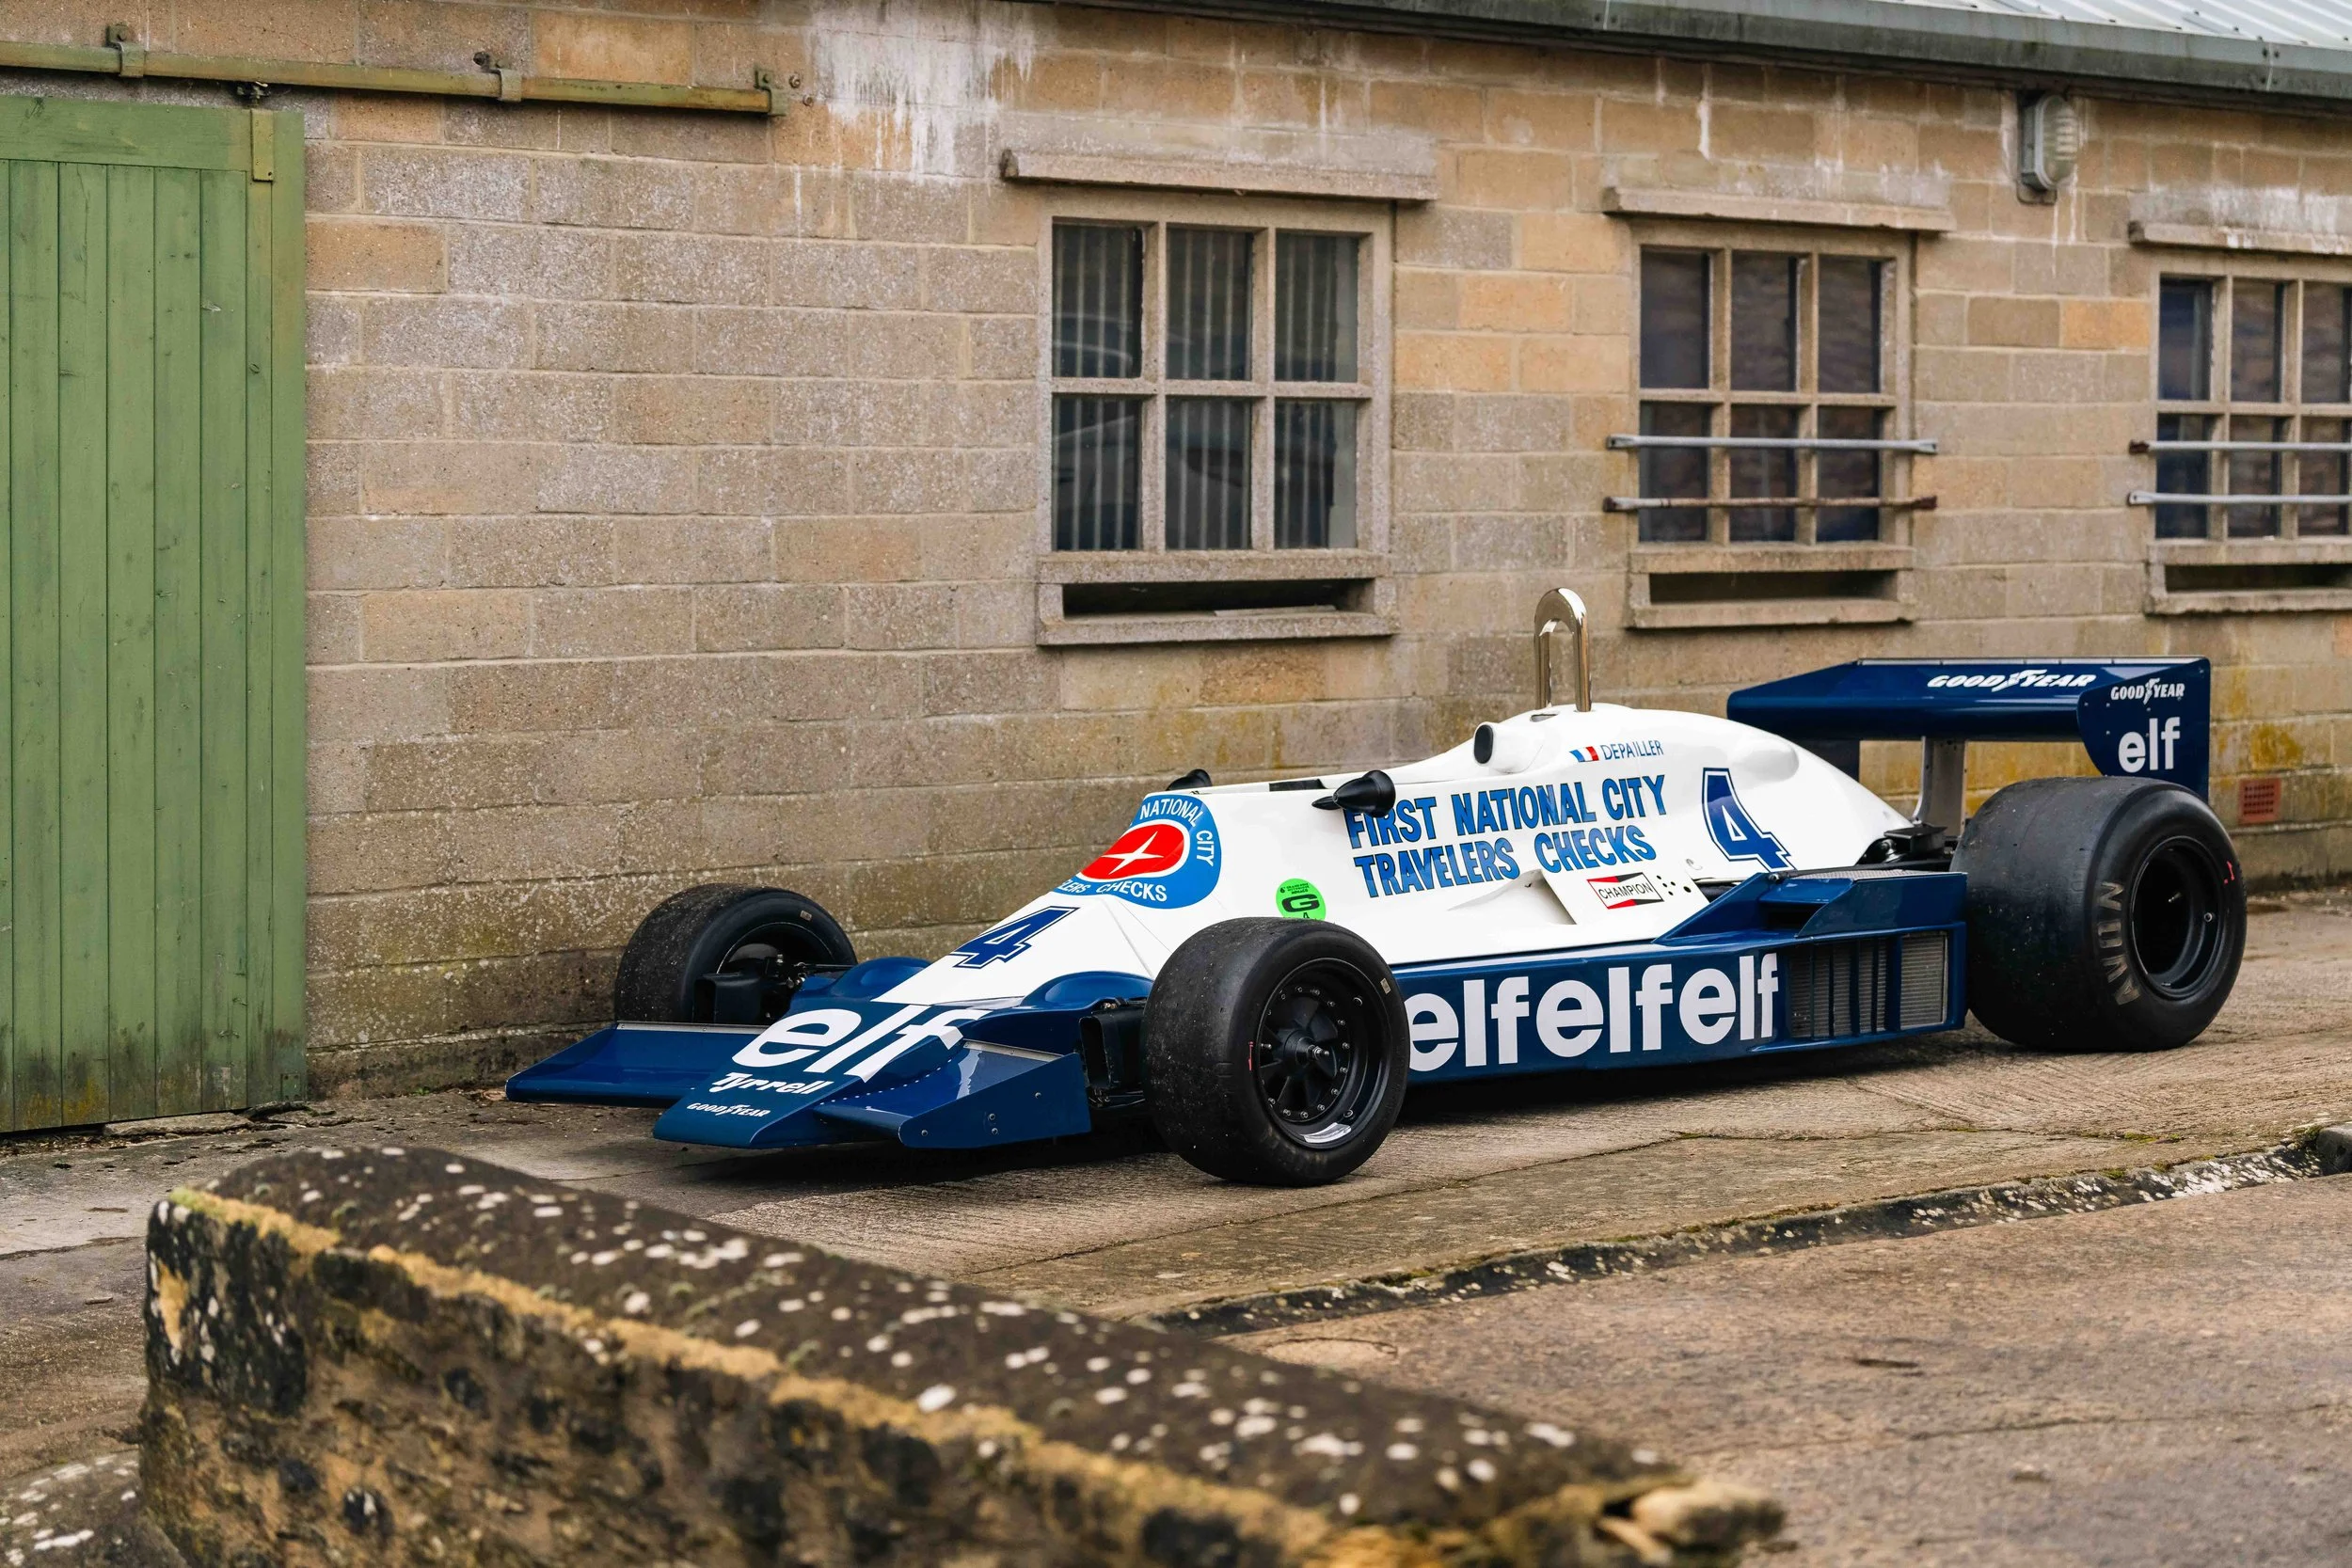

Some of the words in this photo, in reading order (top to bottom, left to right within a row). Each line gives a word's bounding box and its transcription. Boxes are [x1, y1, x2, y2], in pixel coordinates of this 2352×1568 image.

[1927, 669, 2097, 692] GOODYEAR
[2110, 677, 2185, 705] GOODYEAR
[1600, 739, 1664, 761] DEPAILLER
[2118, 716, 2181, 773] elf
[1139, 798, 1204, 828] NATIONAL
[1196, 830, 1215, 867] CITY
[1343, 796, 1438, 849] FIRST
[1451, 781, 1597, 836] NATIONAL
[1601, 774, 1667, 821] CITY
[1701, 767, 1797, 871] 4
[1353, 839, 1521, 898] TRAVELERS
[1534, 824, 1657, 874] CHECKS
[1095, 879, 1168, 903] CHECKS
[1597, 881, 1655, 900] CHAMPION
[948, 906, 1079, 970] 4
[2097, 880, 2141, 1006] AVON
[732, 1005, 993, 1084] elf
[686, 1102, 771, 1117] GOODYEAR
[708, 1071, 835, 1095] Tyrrell
